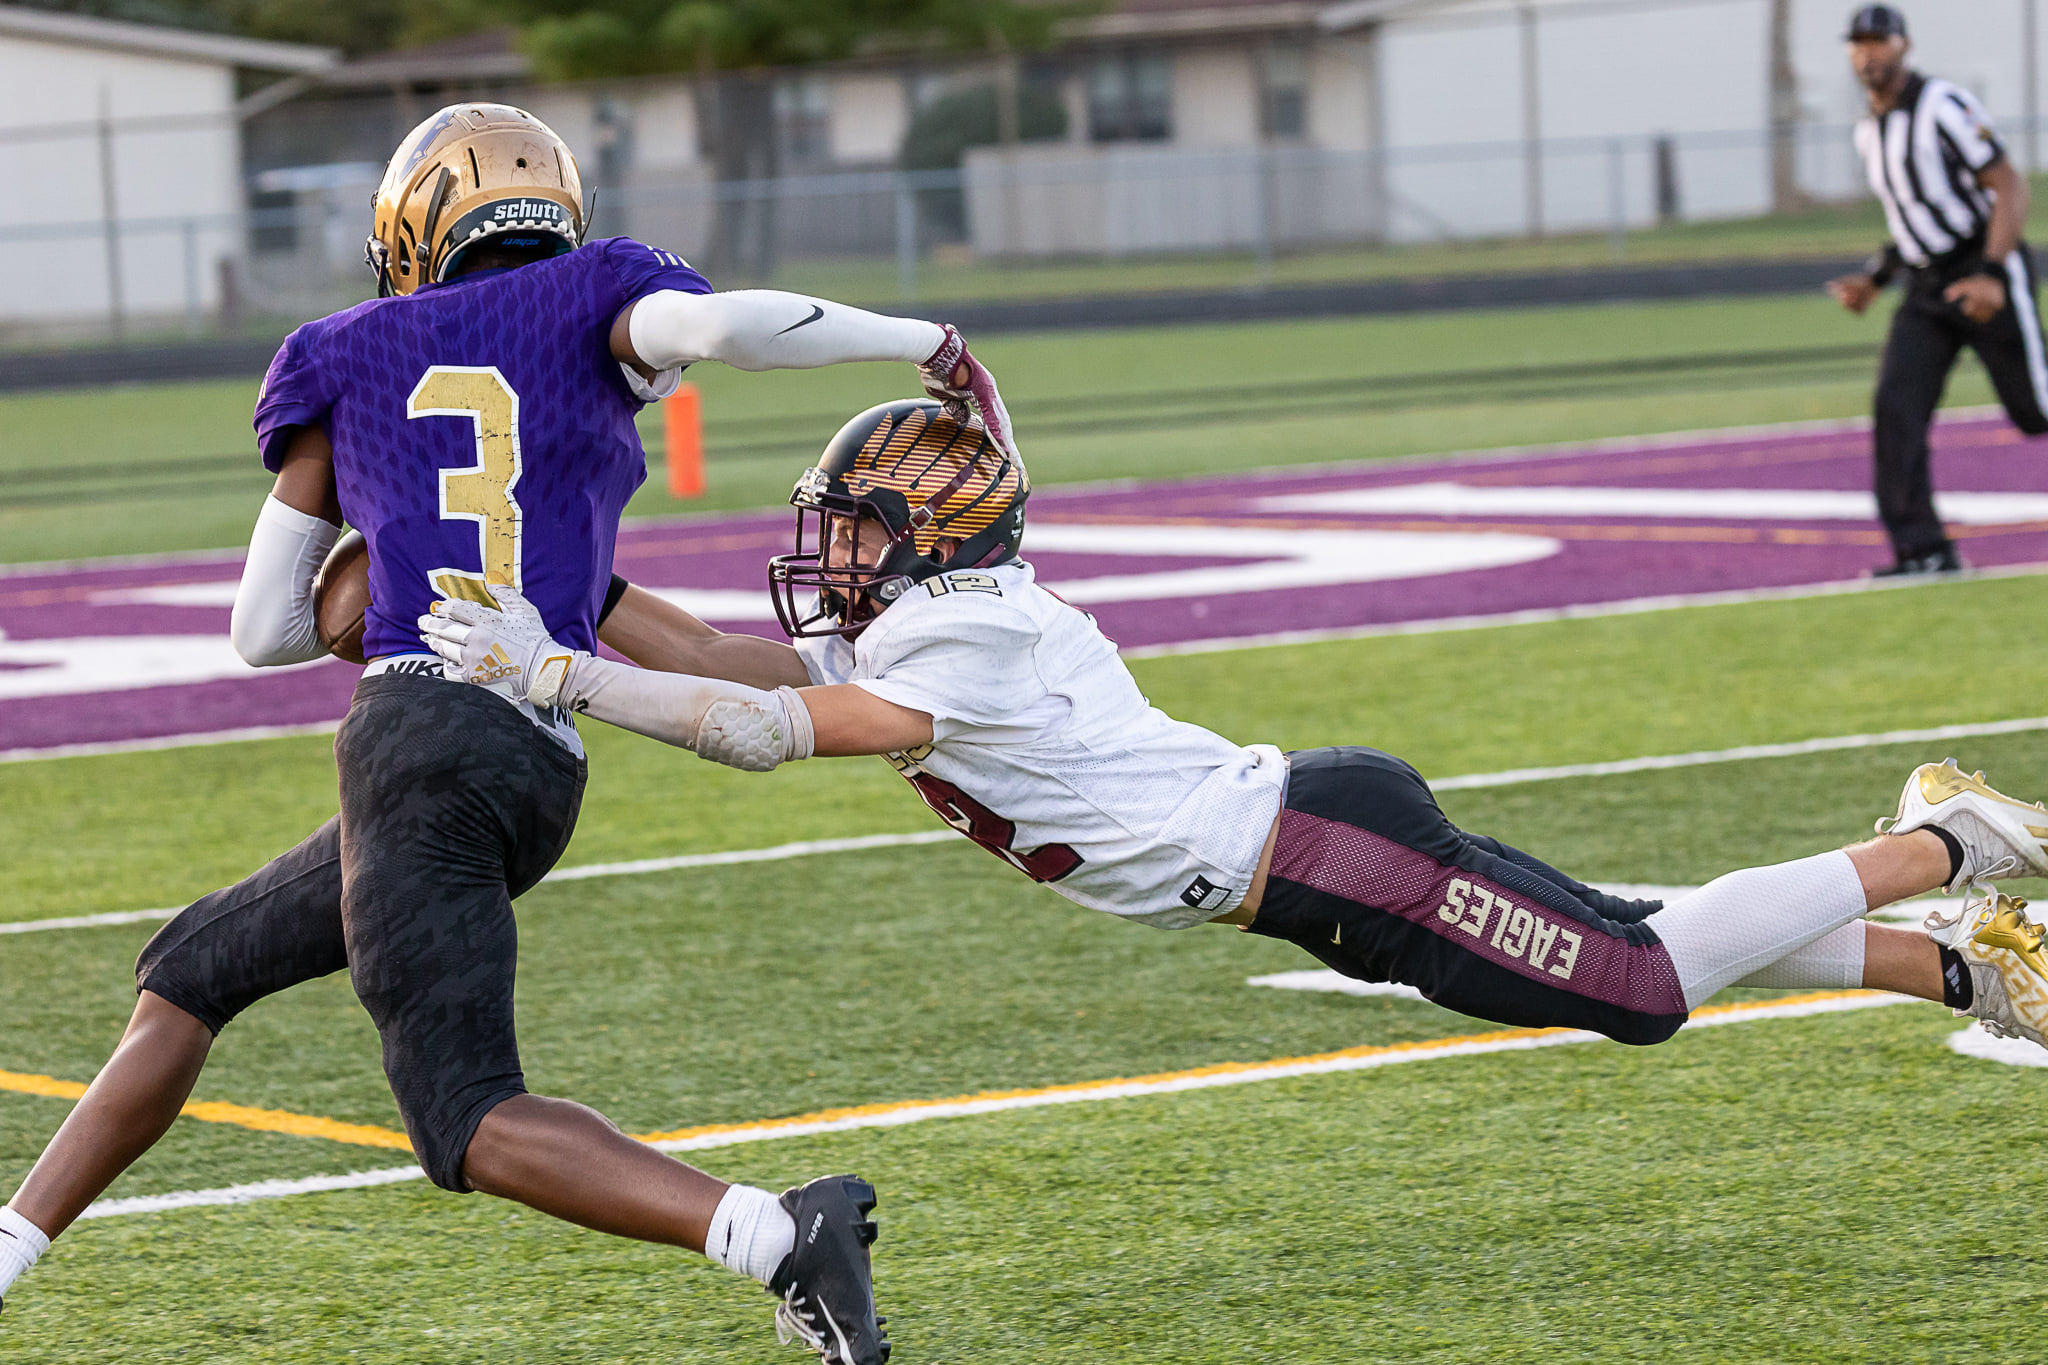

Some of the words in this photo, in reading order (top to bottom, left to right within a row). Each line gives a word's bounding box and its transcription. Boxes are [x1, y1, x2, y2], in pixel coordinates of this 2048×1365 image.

[494, 199, 560, 220] schutt
[407, 365, 523, 612] 3
[919, 574, 1003, 598] 12
[384, 660, 446, 678] NIK
[470, 665, 522, 684] adidas
[1189, 884, 1205, 900] M
[1438, 878, 1583, 980] EAGLES
[806, 1212, 824, 1244] VAPOR
